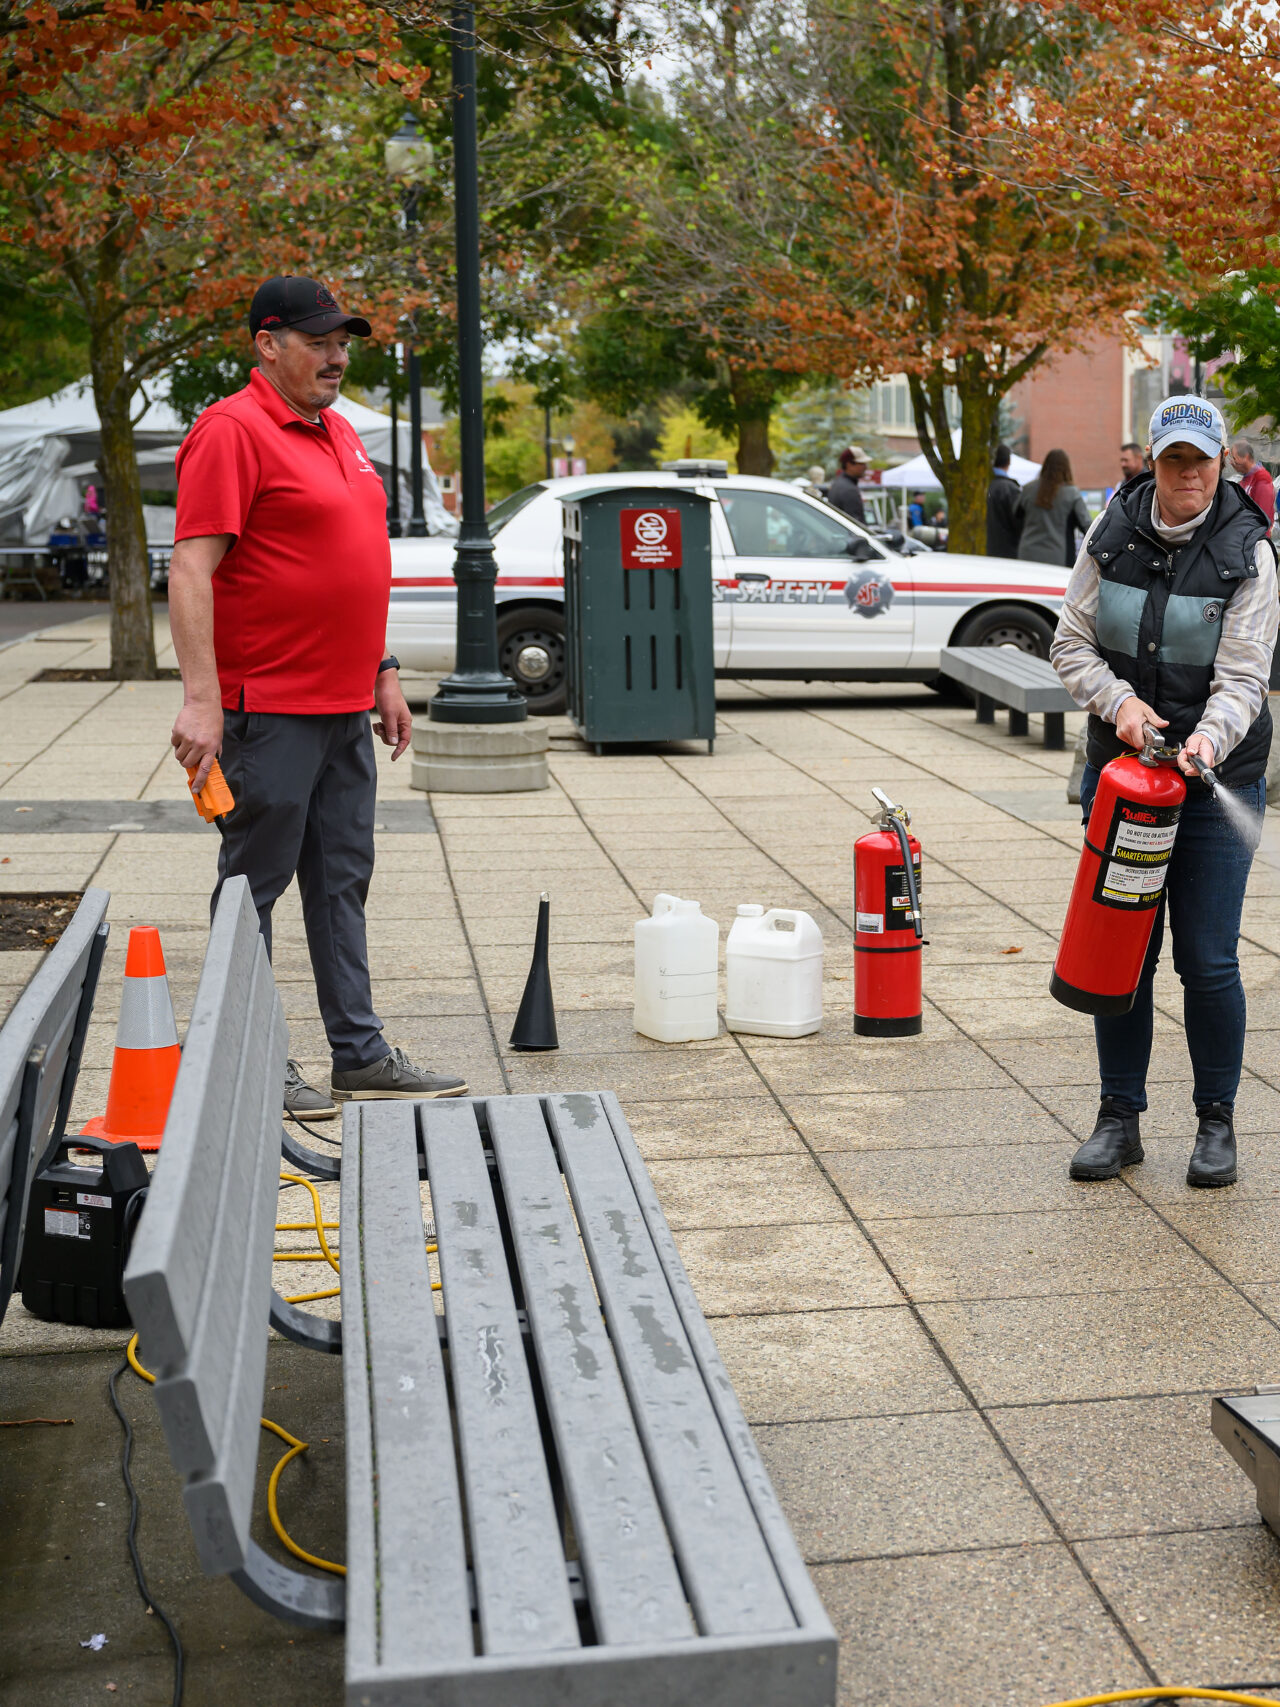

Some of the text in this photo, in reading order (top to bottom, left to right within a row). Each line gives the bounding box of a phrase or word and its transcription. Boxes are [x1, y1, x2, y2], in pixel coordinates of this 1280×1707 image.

[1162, 404, 1212, 428] SHOALS
[736, 581, 833, 604] SAFETY
[1121, 807, 1157, 823] BullEx
